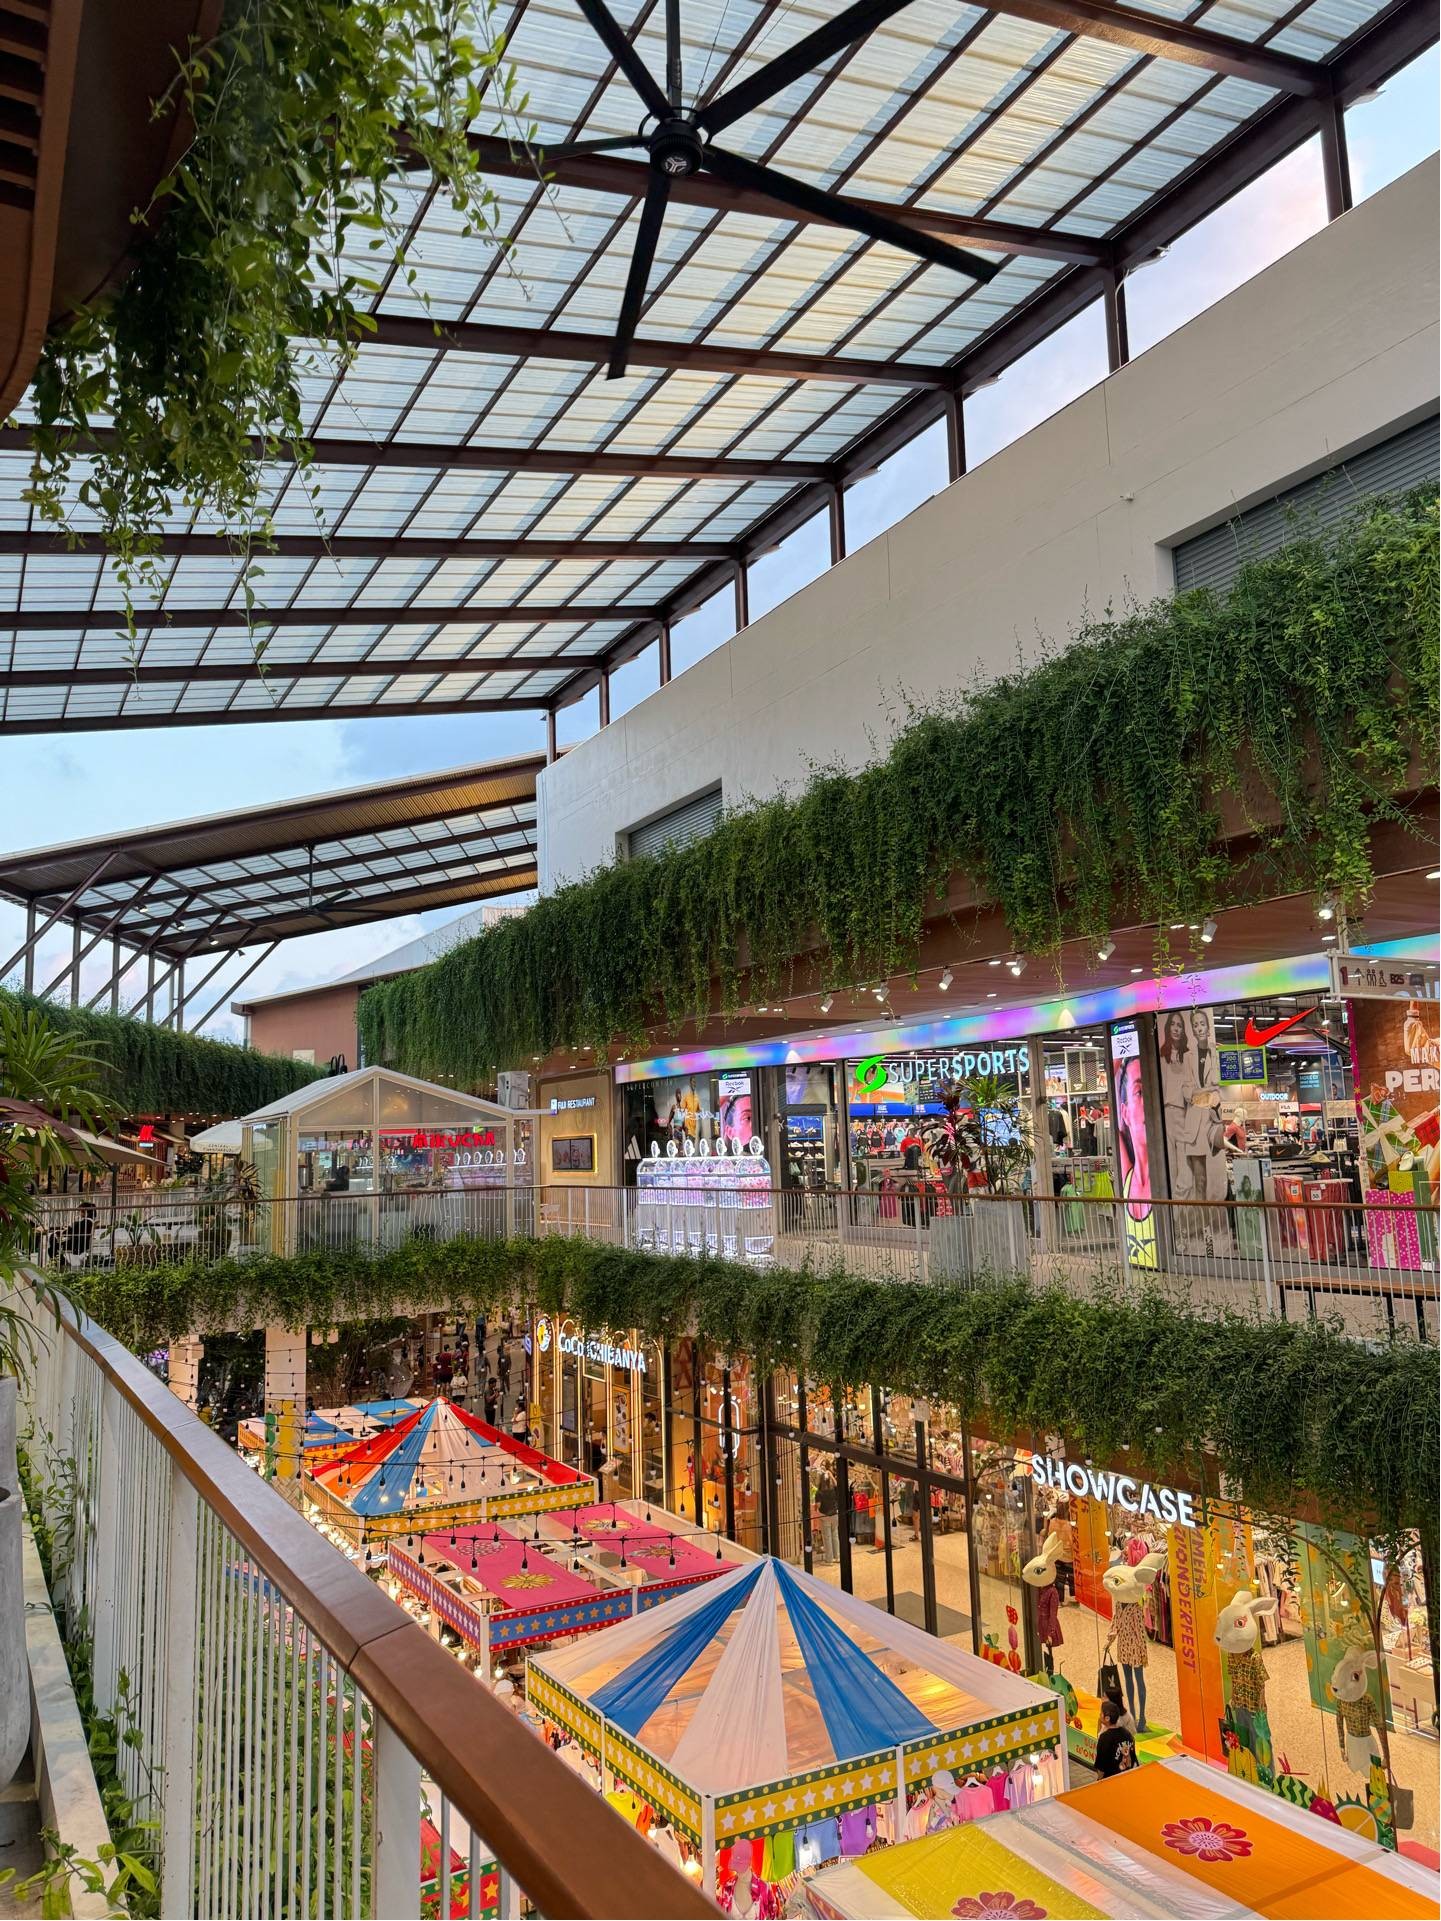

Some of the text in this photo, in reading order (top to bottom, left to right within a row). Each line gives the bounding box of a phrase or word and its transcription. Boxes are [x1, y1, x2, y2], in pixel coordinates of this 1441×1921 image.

[1390, 973, 1405, 985] B2S
[1410, 1046, 1440, 1065] MAK
[889, 1048, 1030, 1083] SUPERSPORTS
[567, 1097, 595, 1109] RESTAURANT
[1260, 1092, 1289, 1101] OUTDOOR
[1032, 1454, 1196, 1528] SHOWCASE
